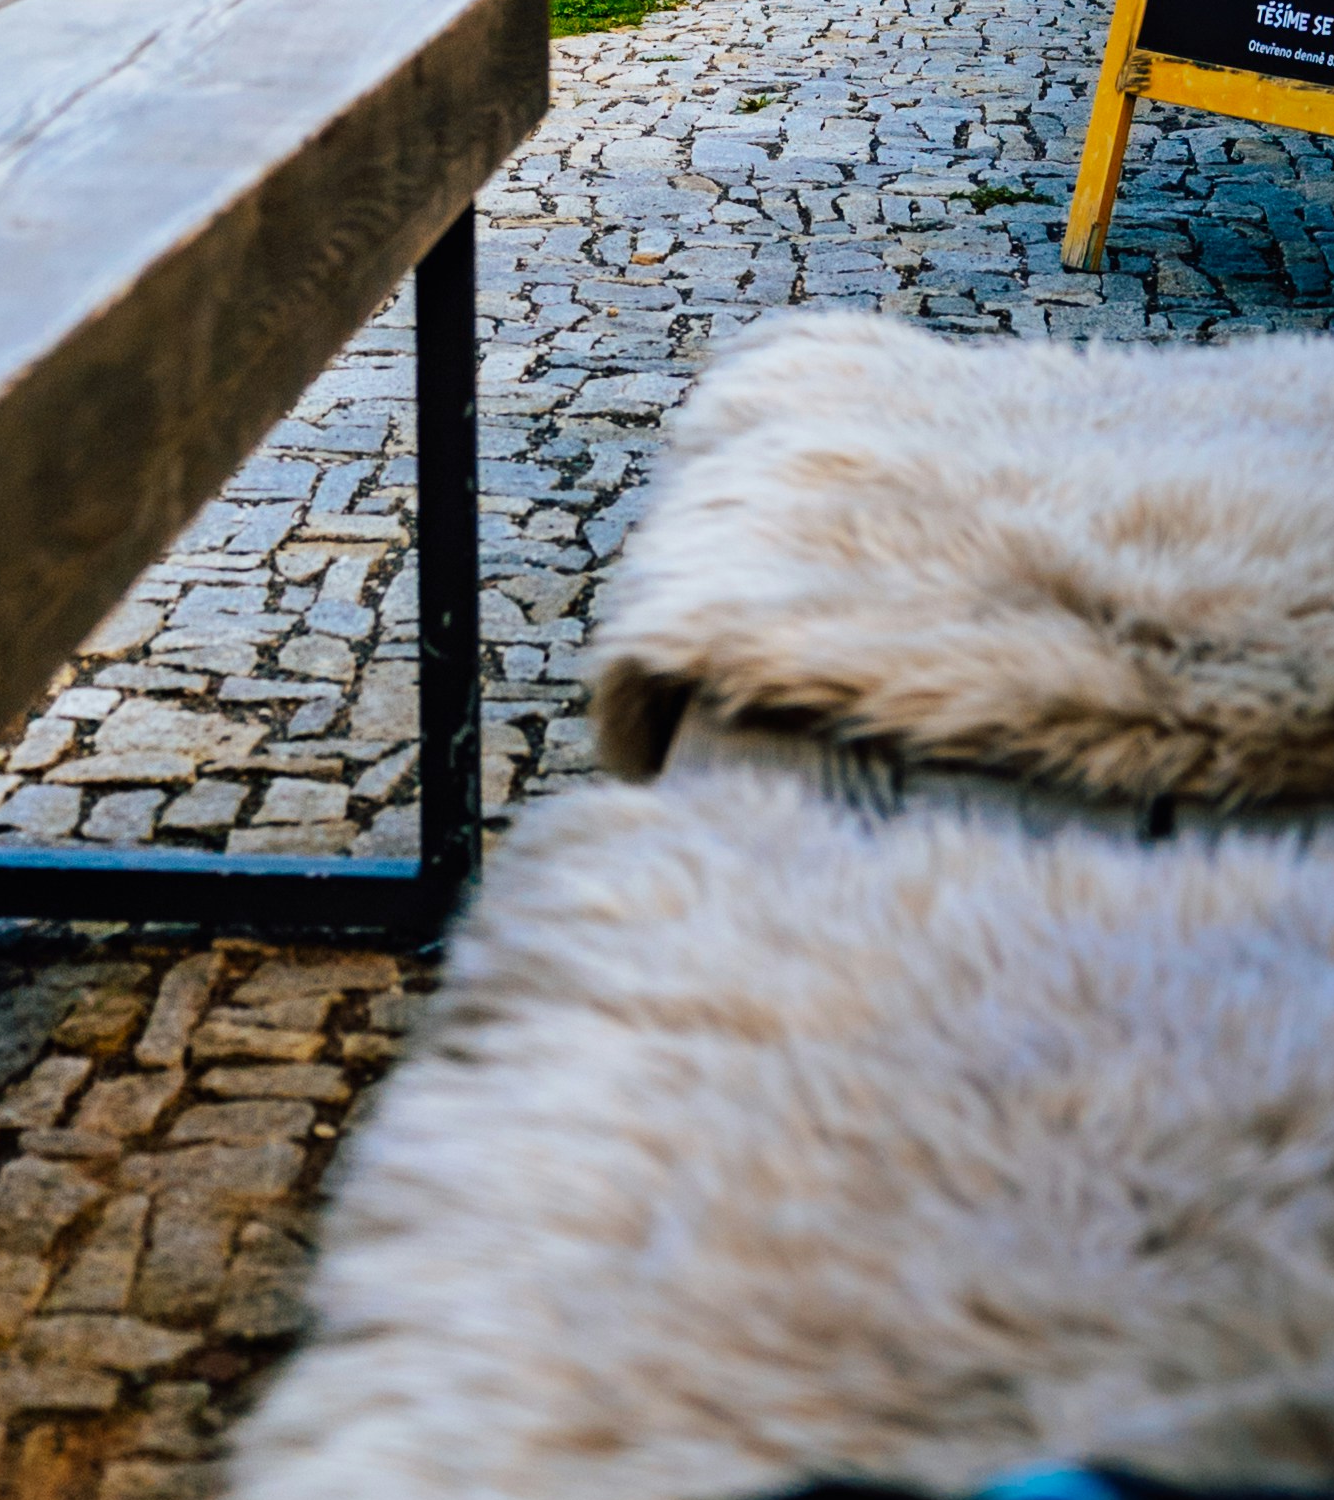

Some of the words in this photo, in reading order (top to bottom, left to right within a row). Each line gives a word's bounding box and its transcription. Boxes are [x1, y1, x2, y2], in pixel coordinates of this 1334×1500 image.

[1256, 0, 1311, 32] TĚŠÍME
[1311, 15, 1334, 36] SE
[1248, 39, 1292, 59] Otevřeno
[1294, 48, 1325, 65] denně
